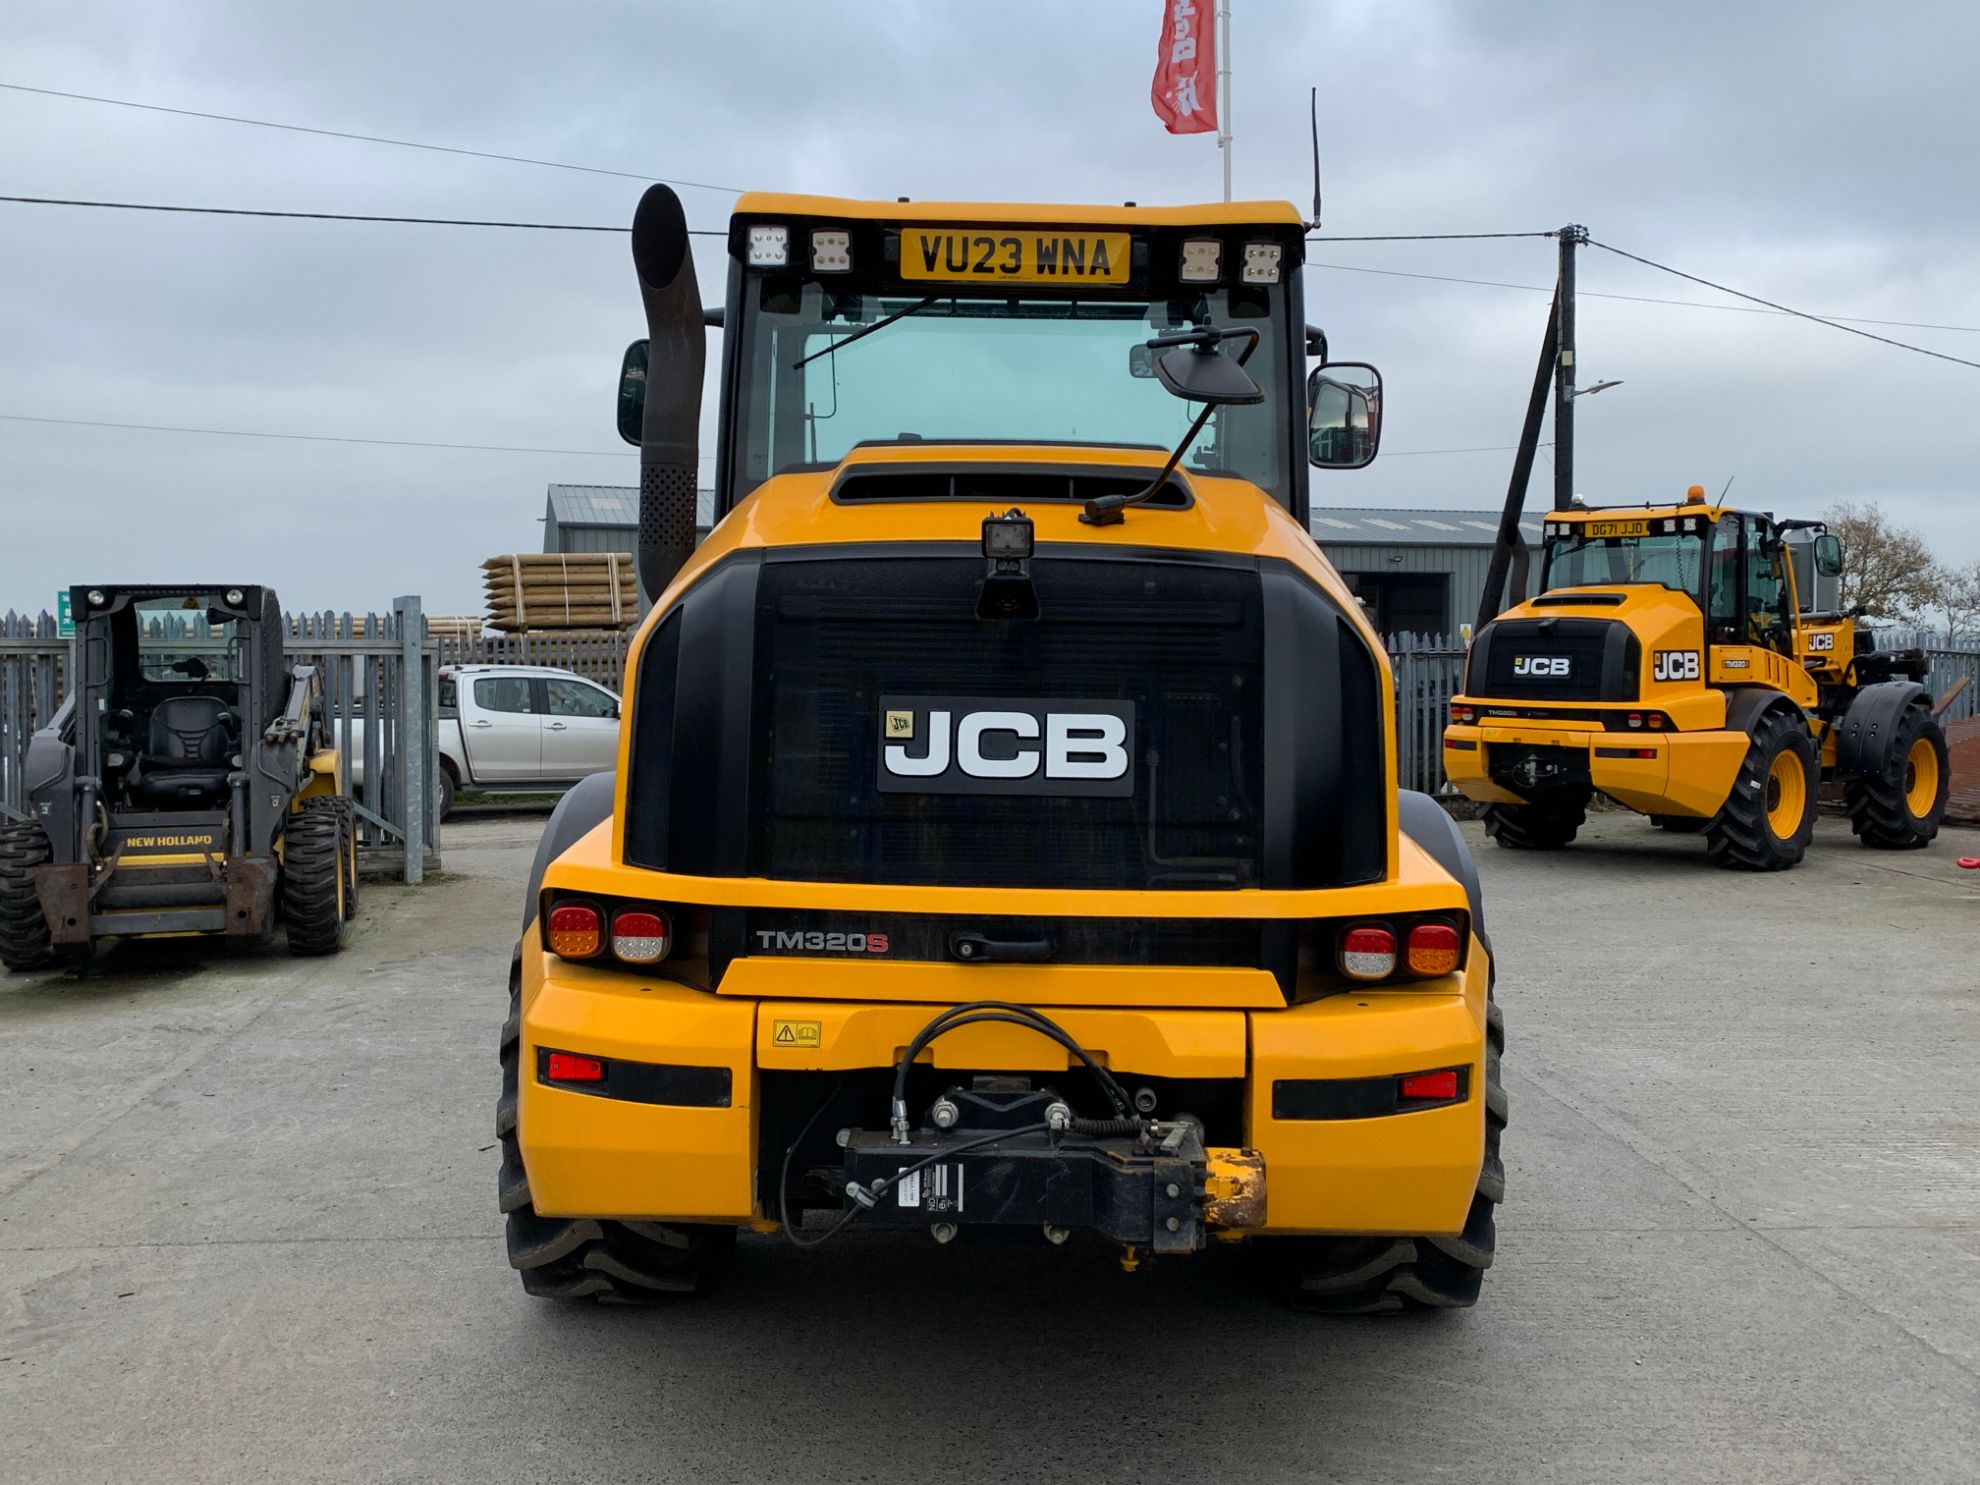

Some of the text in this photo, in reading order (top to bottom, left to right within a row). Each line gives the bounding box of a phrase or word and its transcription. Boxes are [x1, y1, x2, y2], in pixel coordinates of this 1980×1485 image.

[919, 235, 1111, 276] VU23 WNA
[1592, 523, 1617, 536] DG71
[1808, 634, 1834, 651] JCB
[1514, 657, 1570, 676] JCB
[1654, 652, 1699, 680] JCB
[893, 717, 910, 730] JCB
[884, 710, 1129, 779] JCB
[127, 835, 212, 848] NEW HOLLAND
[756, 930, 889, 953] TM320S
